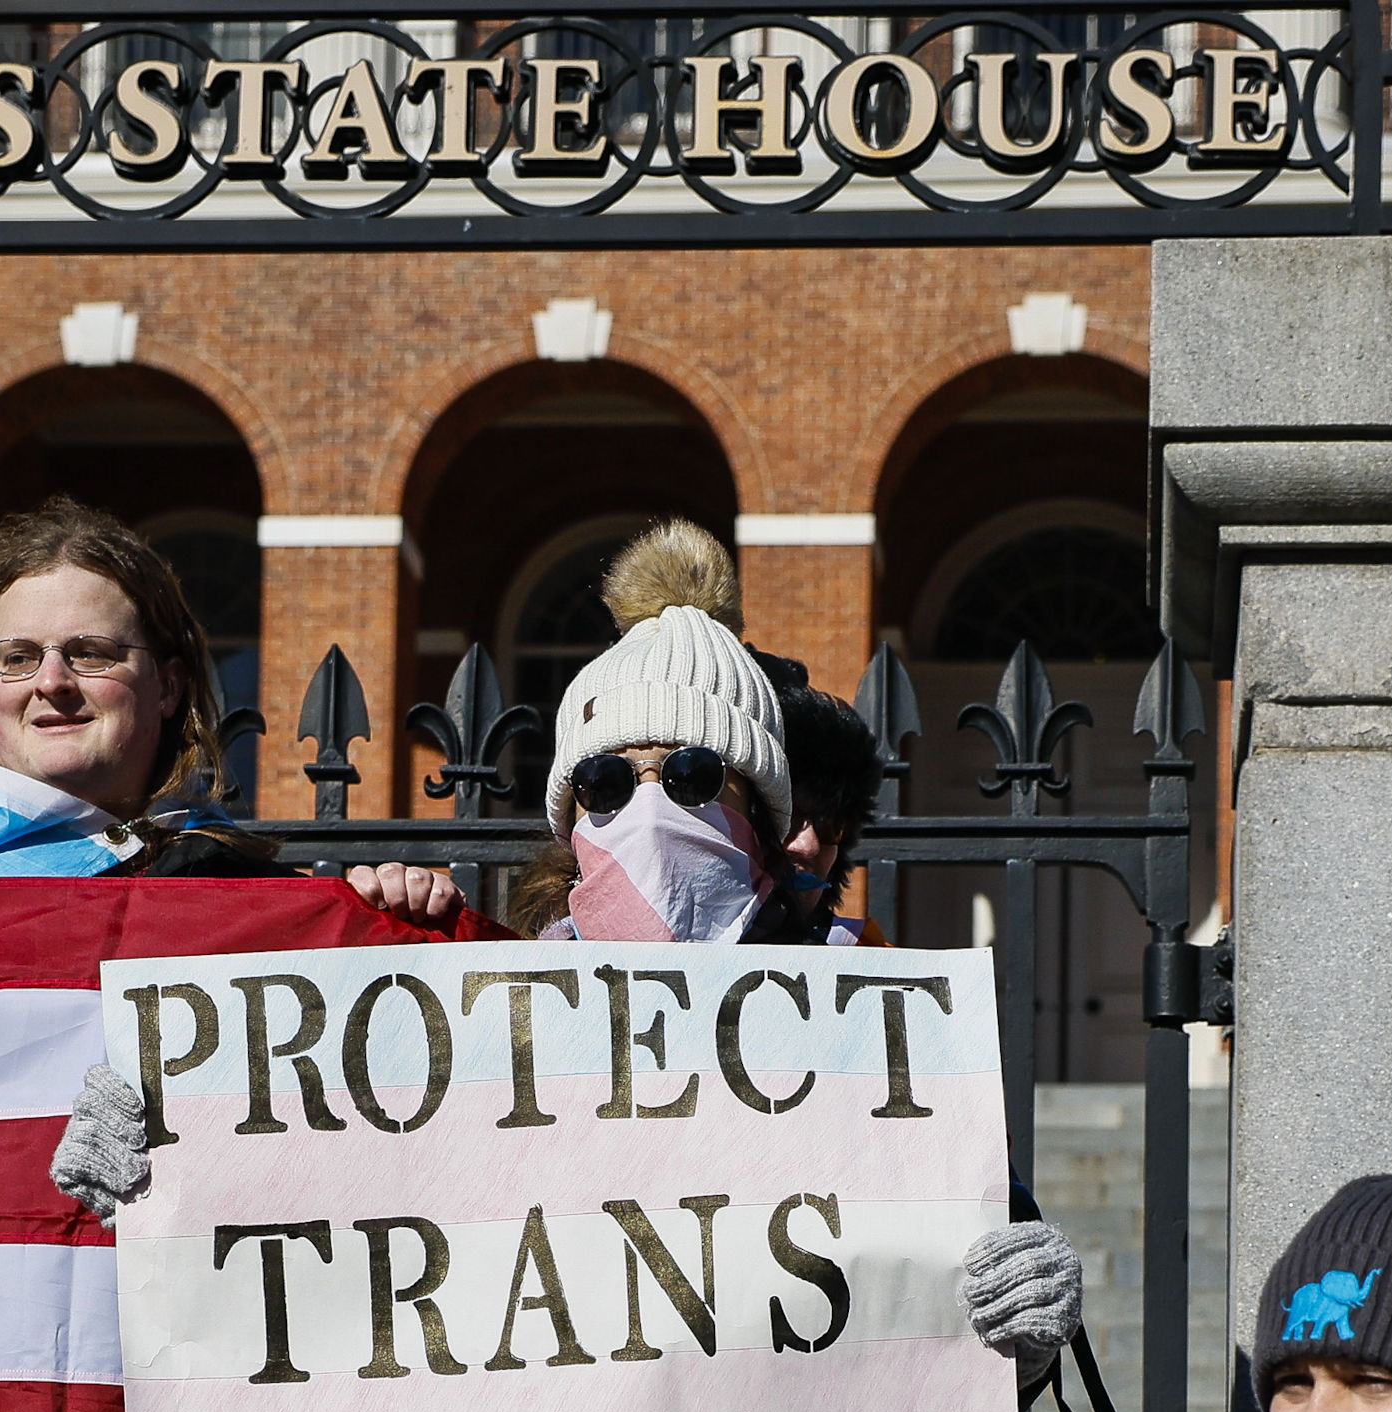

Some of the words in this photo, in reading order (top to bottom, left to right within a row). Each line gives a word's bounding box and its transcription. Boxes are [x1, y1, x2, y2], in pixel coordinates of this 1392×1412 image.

[109, 57, 607, 170] STATE
[682, 48, 1288, 162] HOUSE
[122, 964, 953, 1148] PROTECT
[213, 1192, 851, 1384] TRANS
